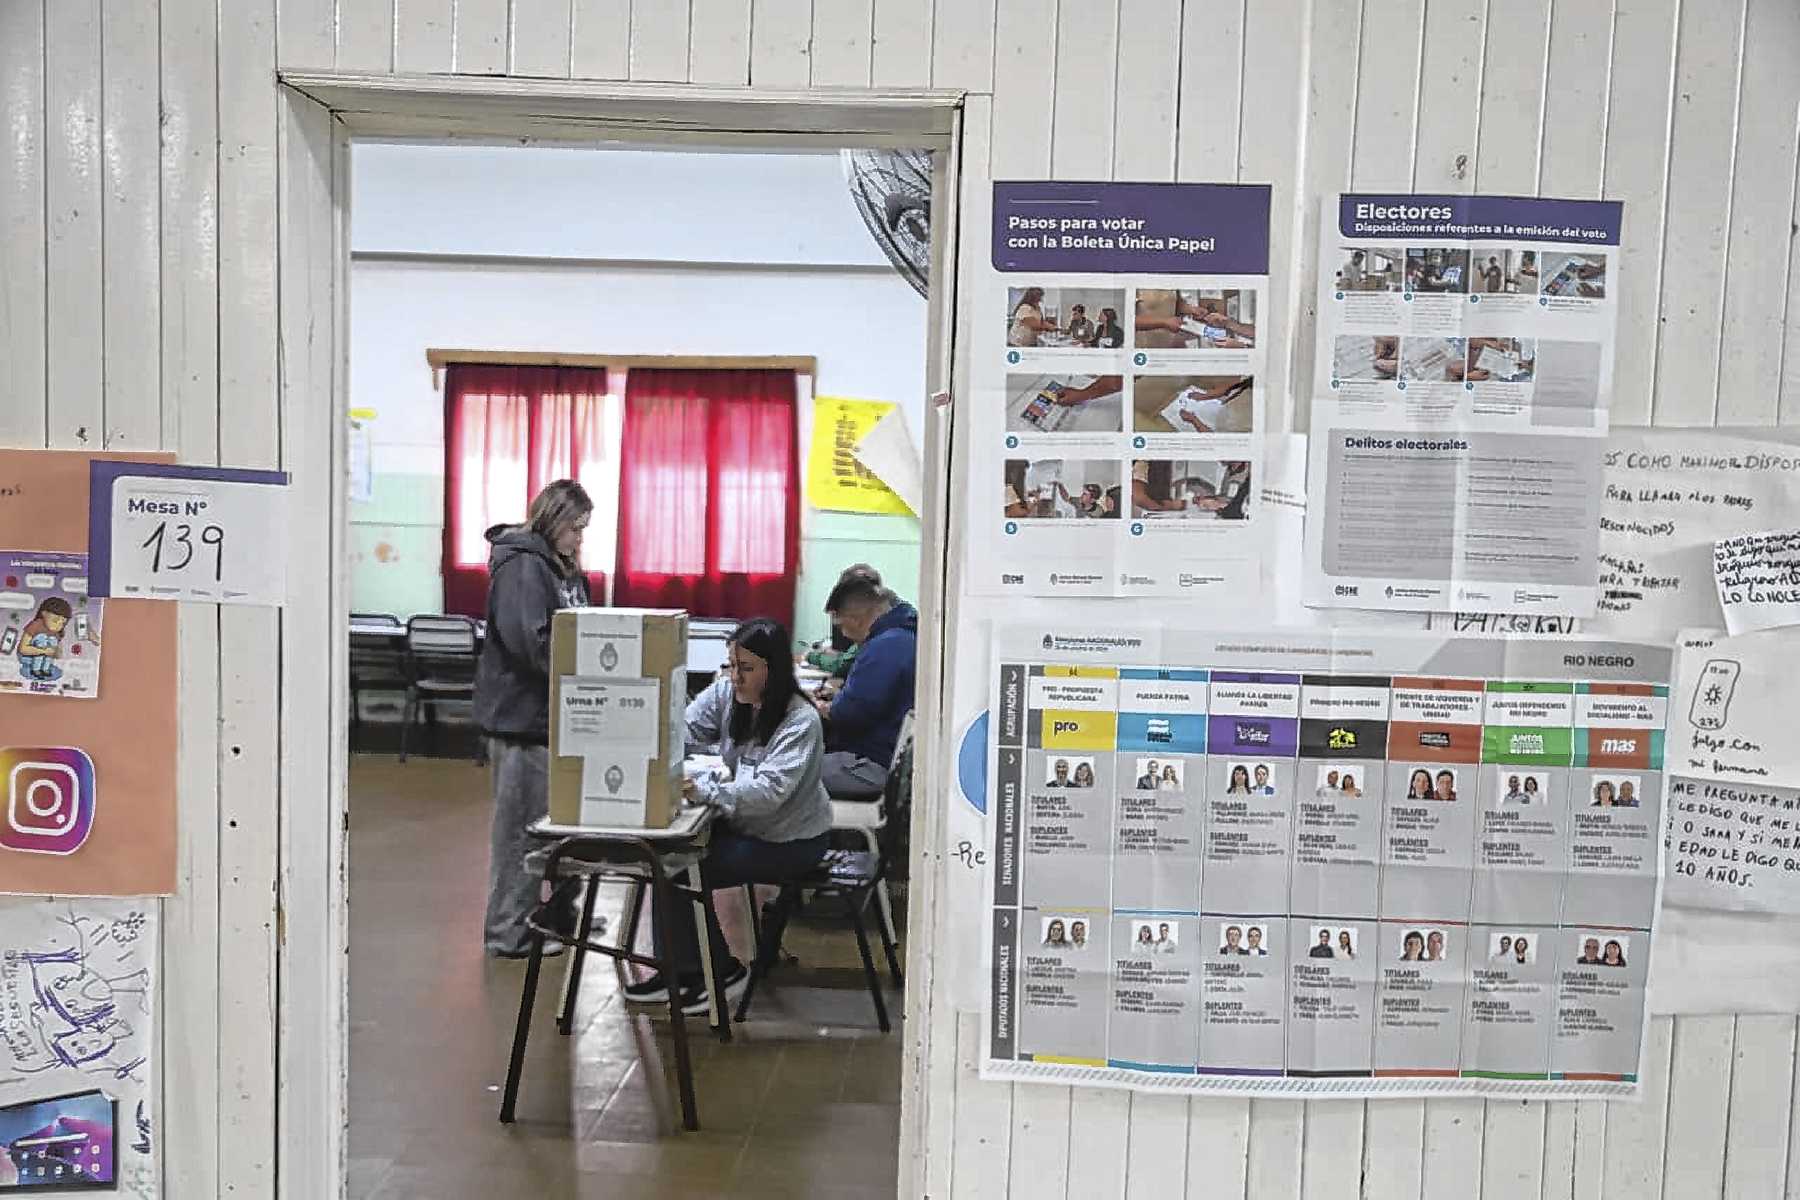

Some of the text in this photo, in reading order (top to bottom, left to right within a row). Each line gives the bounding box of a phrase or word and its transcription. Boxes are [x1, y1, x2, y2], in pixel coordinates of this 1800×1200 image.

[1356, 204, 1452, 220] Electores
[1008, 216, 1145, 233] Pasos para votar
[1355, 222, 1608, 240] Disposiciones referentes a la emisión del voto
[1008, 233, 1215, 254] con la Boleta Única Papel
[1345, 436, 1468, 451] Delitos electorales
[128, 498, 179, 515] Mesa
[142, 521, 223, 581] 139
[1564, 655, 1635, 668] RIO NEGRO
[566, 697, 592, 707] Urna
[1054, 720, 1079, 736] pro
[1602, 738, 1637, 752] mas
[1679, 841, 1718, 857] EDAD
